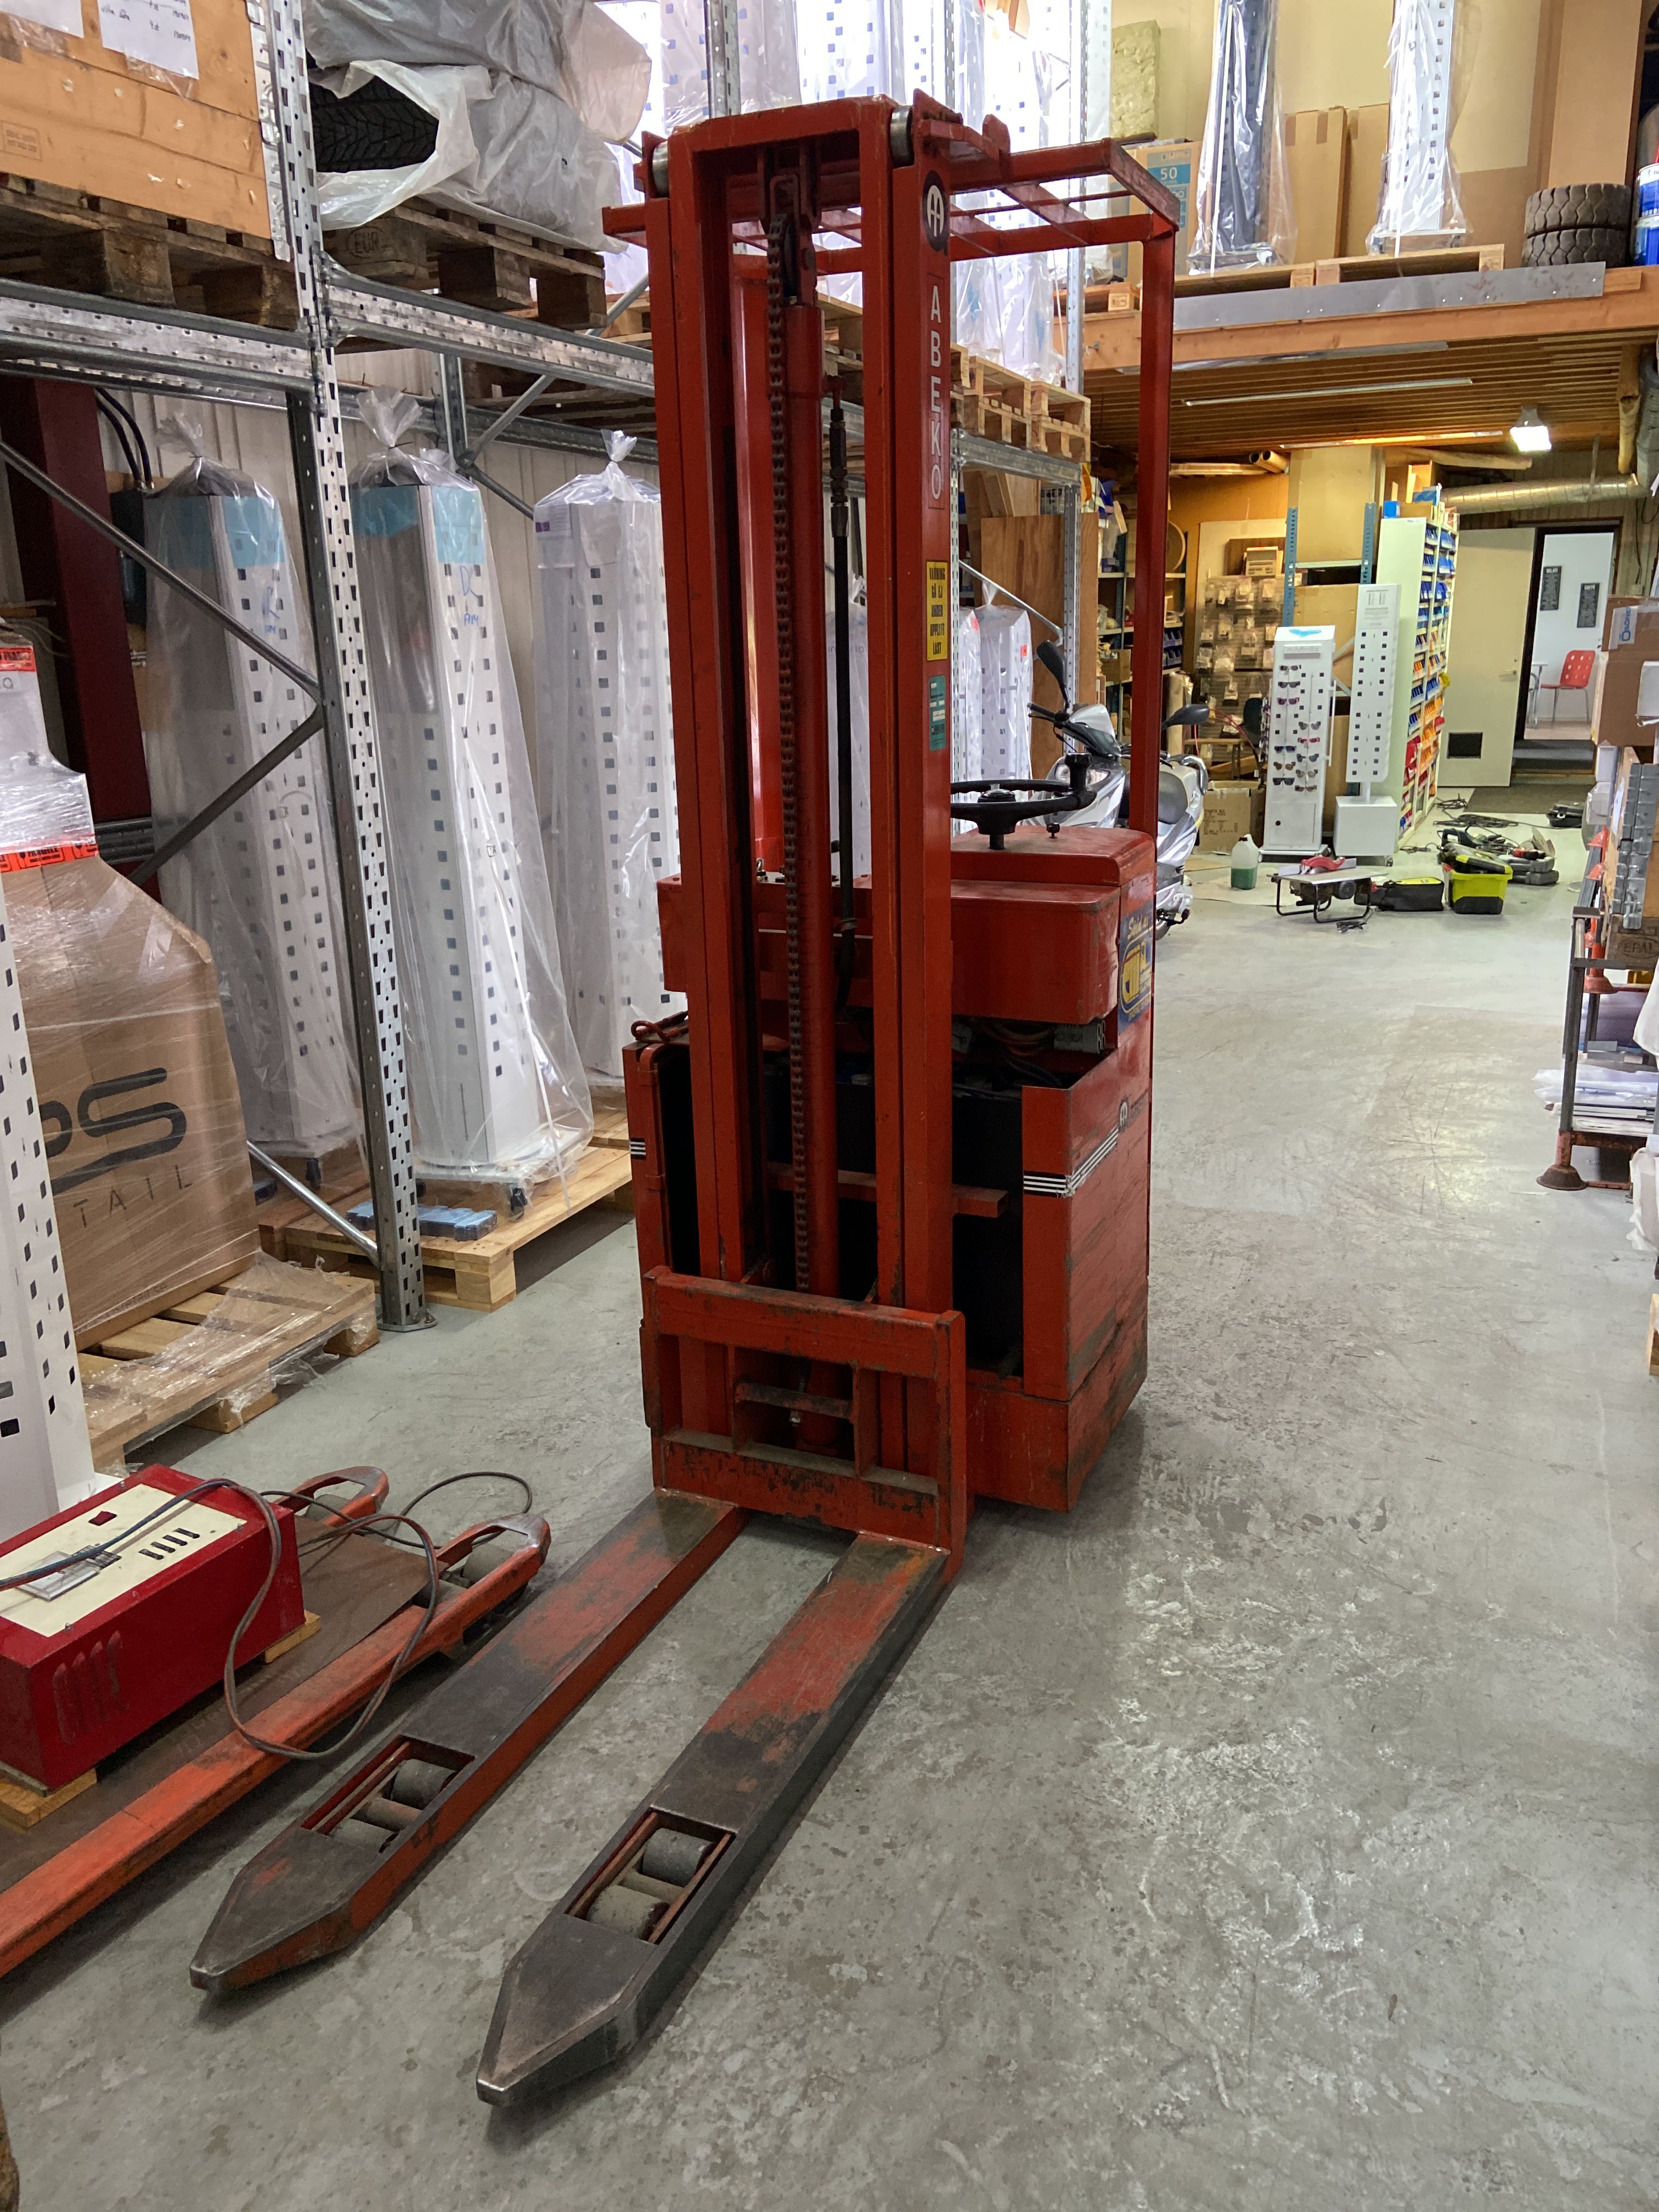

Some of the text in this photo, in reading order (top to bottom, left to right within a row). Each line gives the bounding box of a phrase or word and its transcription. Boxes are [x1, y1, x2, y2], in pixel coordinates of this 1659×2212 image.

[1160, 167, 1178, 180] 50
[354, 232, 379, 253] EUR
[930, 285, 941, 500] ABEKO
[933, 642, 941, 655] LAST
